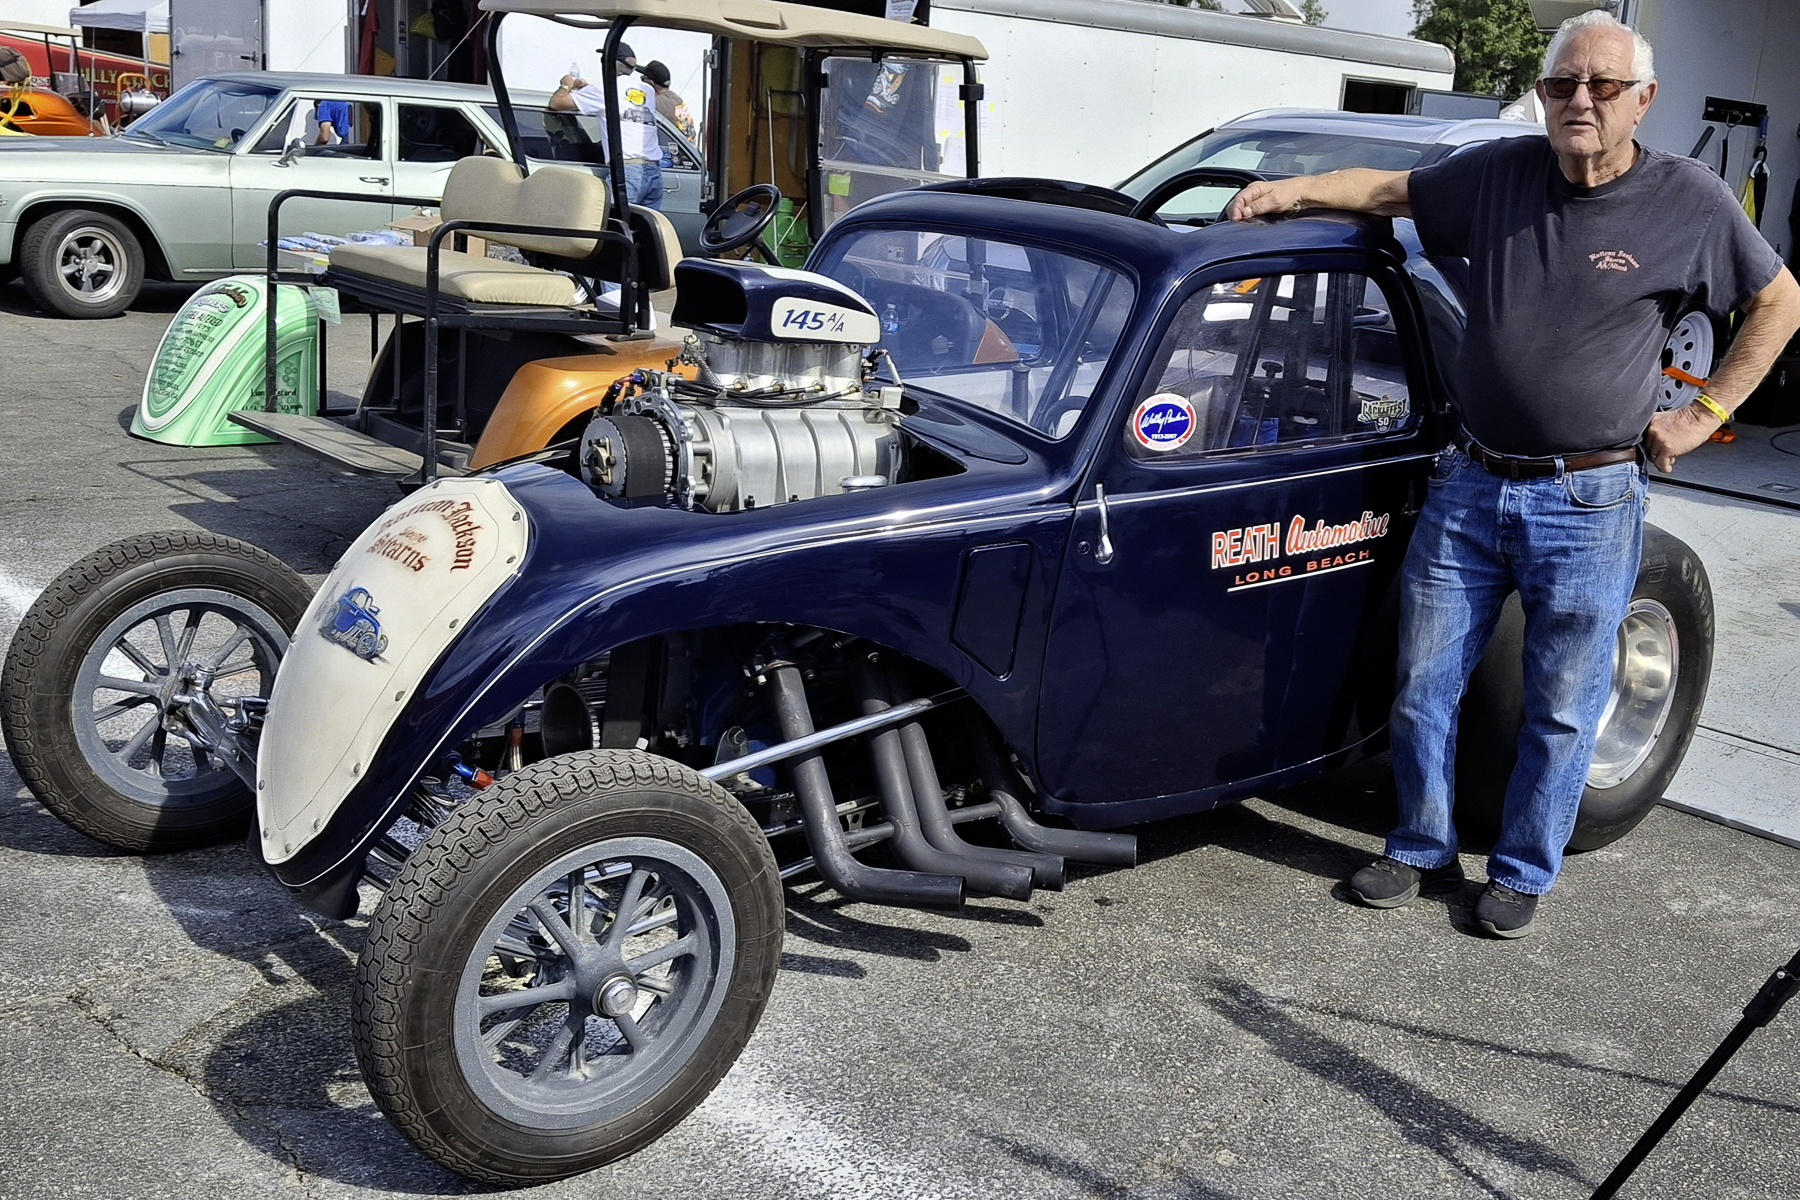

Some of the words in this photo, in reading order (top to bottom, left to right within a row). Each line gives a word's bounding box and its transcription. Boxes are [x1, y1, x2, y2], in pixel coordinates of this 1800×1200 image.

[782, 309, 826, 330] 145
[827, 312, 845, 332] A/A
[1378, 417, 1389, 426] 50
[440, 501, 484, 574] Jackson
[1212, 522, 1280, 569] REATH
[1286, 511, 1390, 556] Automotive
[1235, 565, 1292, 585] LONG
[1306, 550, 1370, 571] BEACH
[557, 793, 648, 827] MICHELIN
